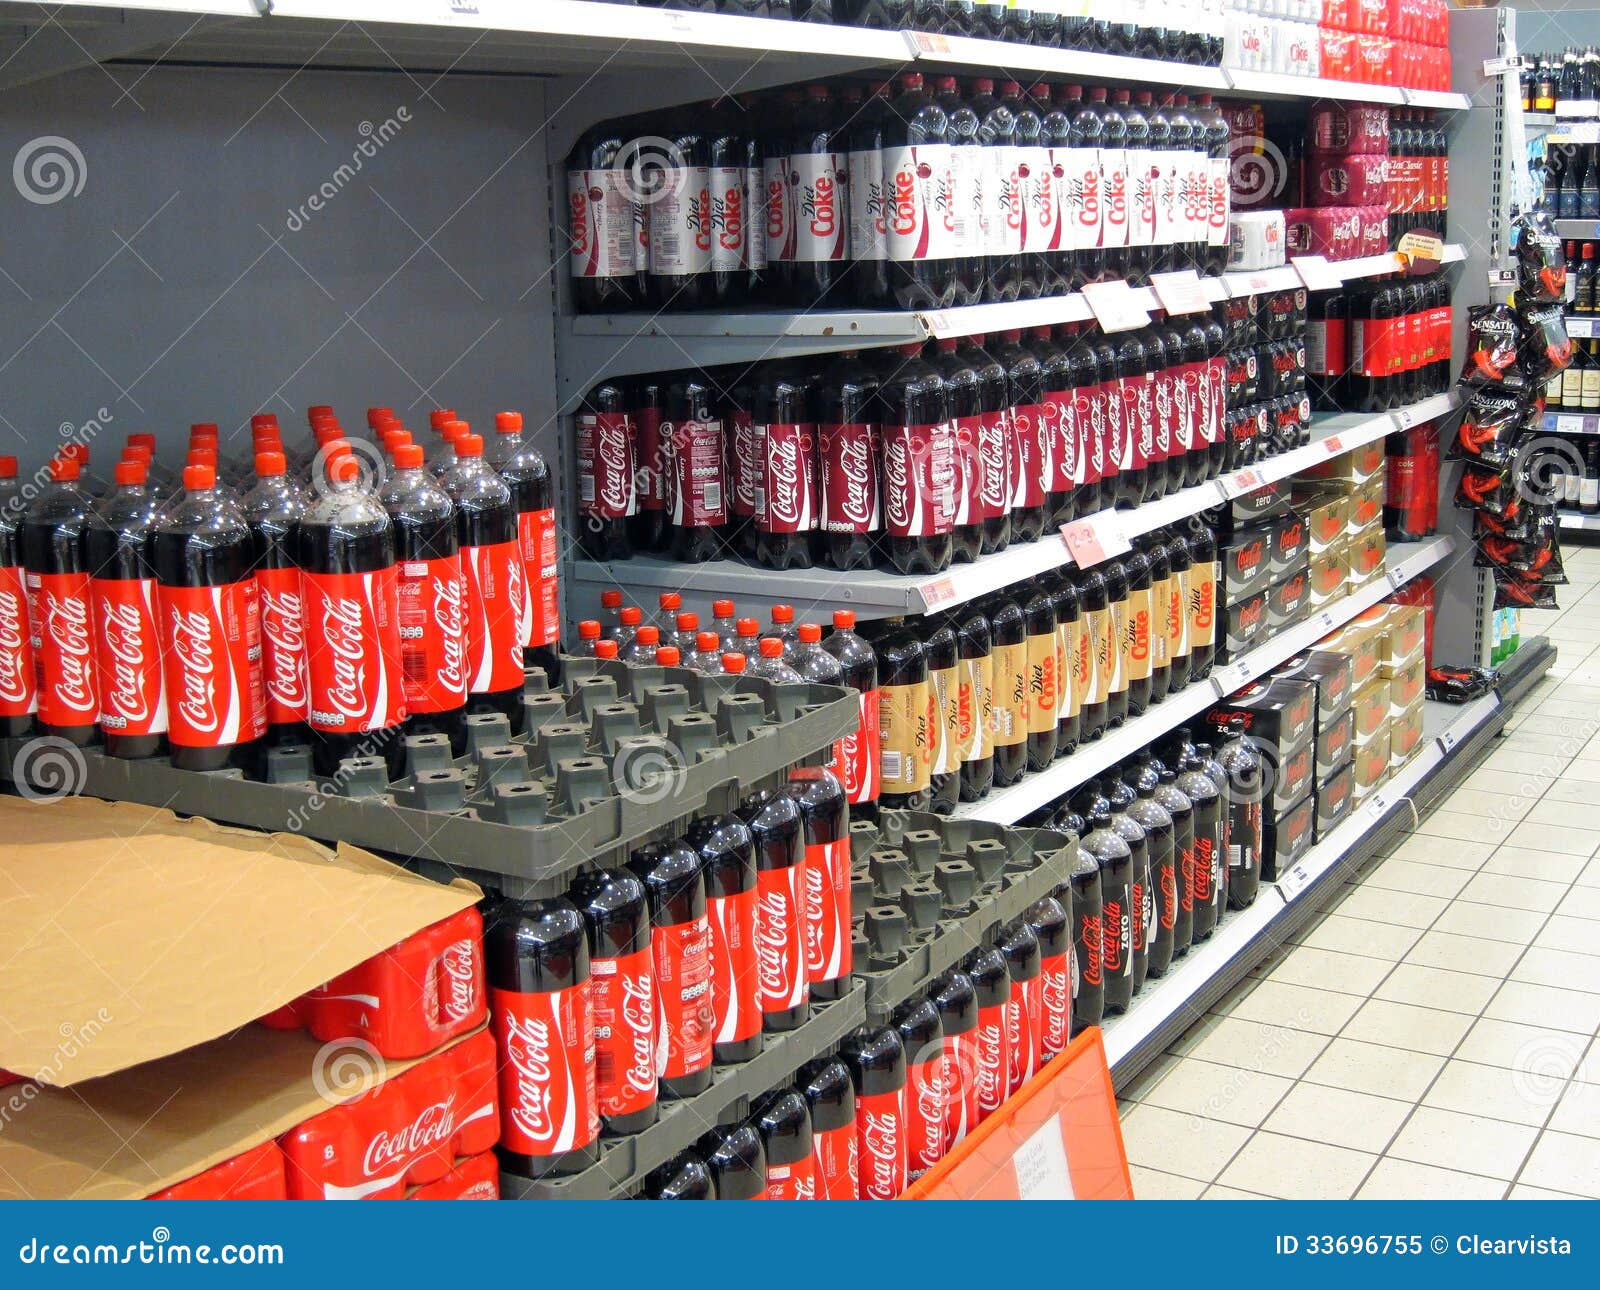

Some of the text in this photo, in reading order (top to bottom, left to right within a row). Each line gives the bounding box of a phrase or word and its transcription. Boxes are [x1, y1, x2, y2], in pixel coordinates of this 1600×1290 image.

[801, 183, 815, 217] Diet
[810, 176, 835, 237] Coke
[866, 183, 881, 219] Diet
[892, 170, 917, 236] Coke
[1000, 178, 1011, 211] Diet
[1078, 170, 1099, 227] Coke
[1108, 171, 1126, 226] Coke
[1208, 177, 1226, 228] Coke
[686, 197, 699, 232] Diet
[711, 197, 724, 231] Diet
[720, 188, 742, 250] Coke
[1471, 319, 1516, 331] SENSATIO
[600, 425, 626, 512] Coca-Cola
[769, 435, 798, 523] Coca-Cola
[841, 435, 870, 523] Coca-Cola
[1255, 494, 1271, 508] zero
[1285, 548, 1297, 560] zero
[1244, 568, 1256, 581] zero
[1191, 588, 1201, 616] Diet
[1195, 581, 1213, 629] Coke
[1285, 601, 1298, 613] zero
[1131, 610, 1149, 661] Coke
[1244, 624, 1256, 636] zero
[46, 589, 95, 711] Coca-Cola
[103, 596, 148, 721] Coca-Cola
[172, 604, 218, 732] Coca-Cola
[322, 592, 367, 717] Coca-Cola
[1072, 650, 1081, 679] Diet
[1099, 637, 1107, 666] Diet
[1014, 673, 1023, 705] Diet
[1030, 664, 1043, 696] Diet
[1038, 655, 1054, 711] Coke
[949, 699, 958, 730] Diet
[983, 687, 992, 717] Diet
[916, 714, 926, 748] Diet
[1218, 725, 1229, 735] ze
[1121, 915, 1129, 951] zero
[1042, 969, 1066, 1055] Coca-Cola
[622, 972, 656, 1092] Coca-Cola
[505, 1007, 554, 1141] Coca-Cola
[363, 1090, 456, 1177] Coca-Cola
[324, 1144, 334, 1160] 8
